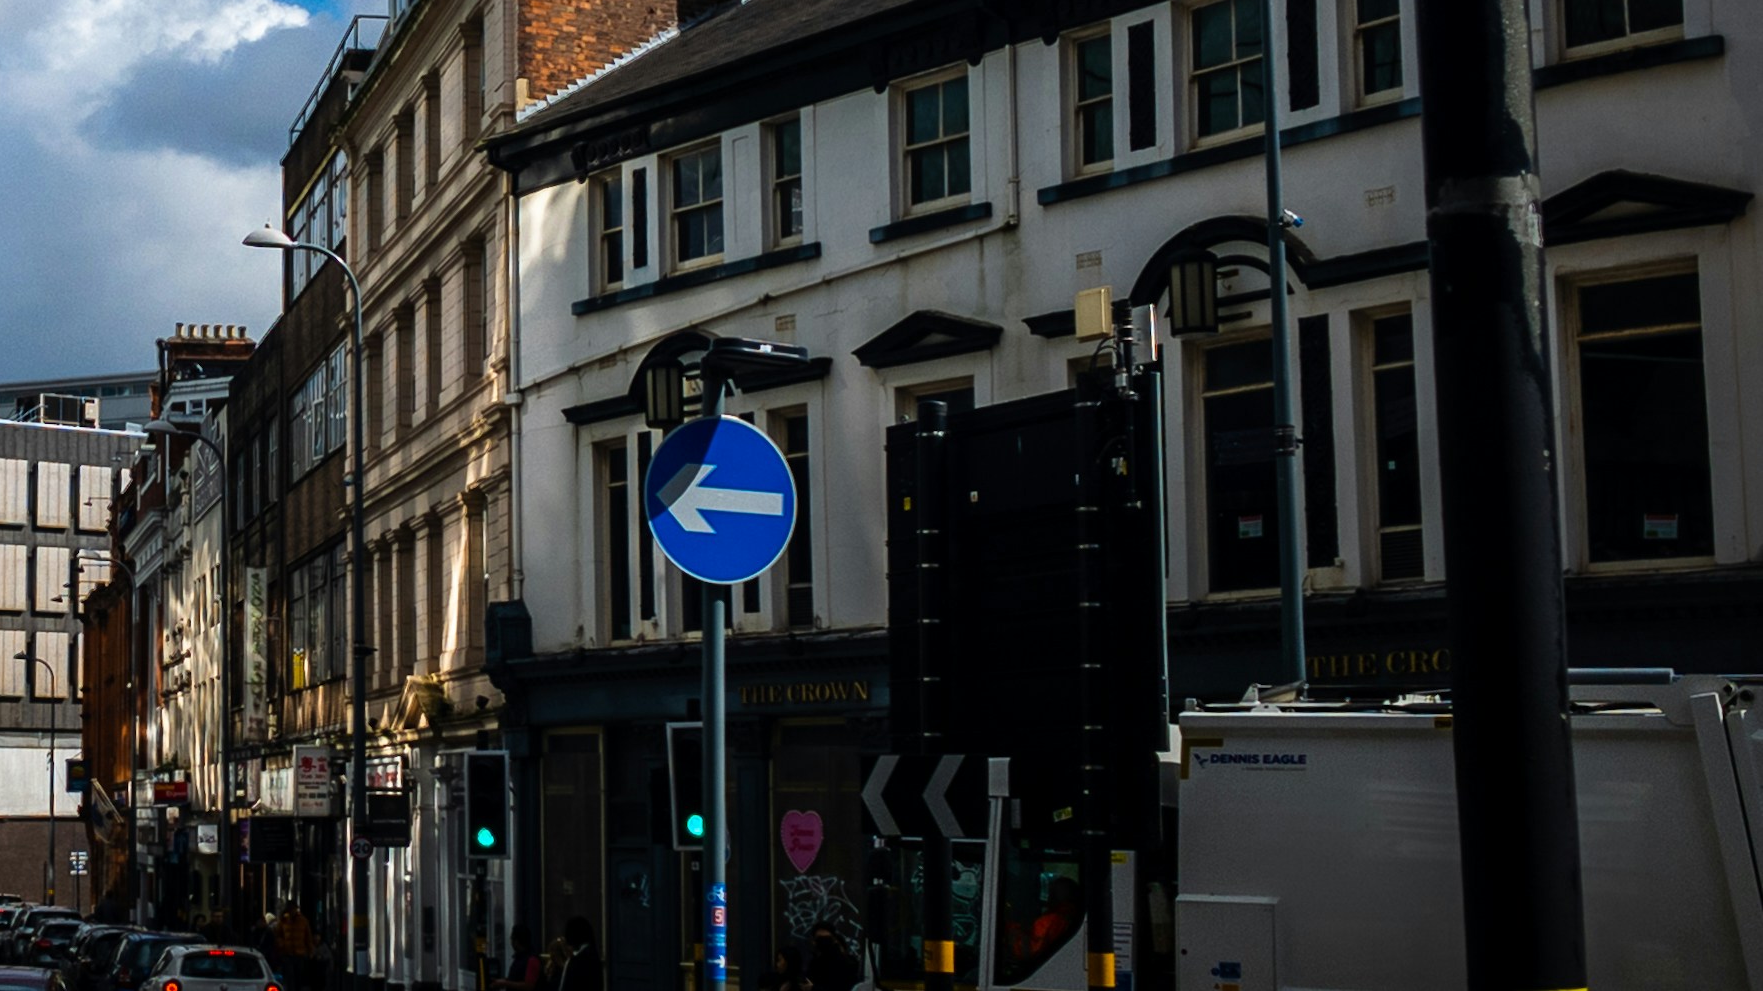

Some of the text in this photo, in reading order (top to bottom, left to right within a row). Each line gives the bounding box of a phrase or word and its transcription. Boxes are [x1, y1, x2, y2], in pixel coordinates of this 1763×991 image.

[1307, 648, 1453, 679] THE CRO
[740, 680, 868, 705] THE CROWN
[1210, 753, 1307, 765] DENNIS EAGLE
[354, 843, 370, 854] 20
[714, 909, 724, 925] 5
